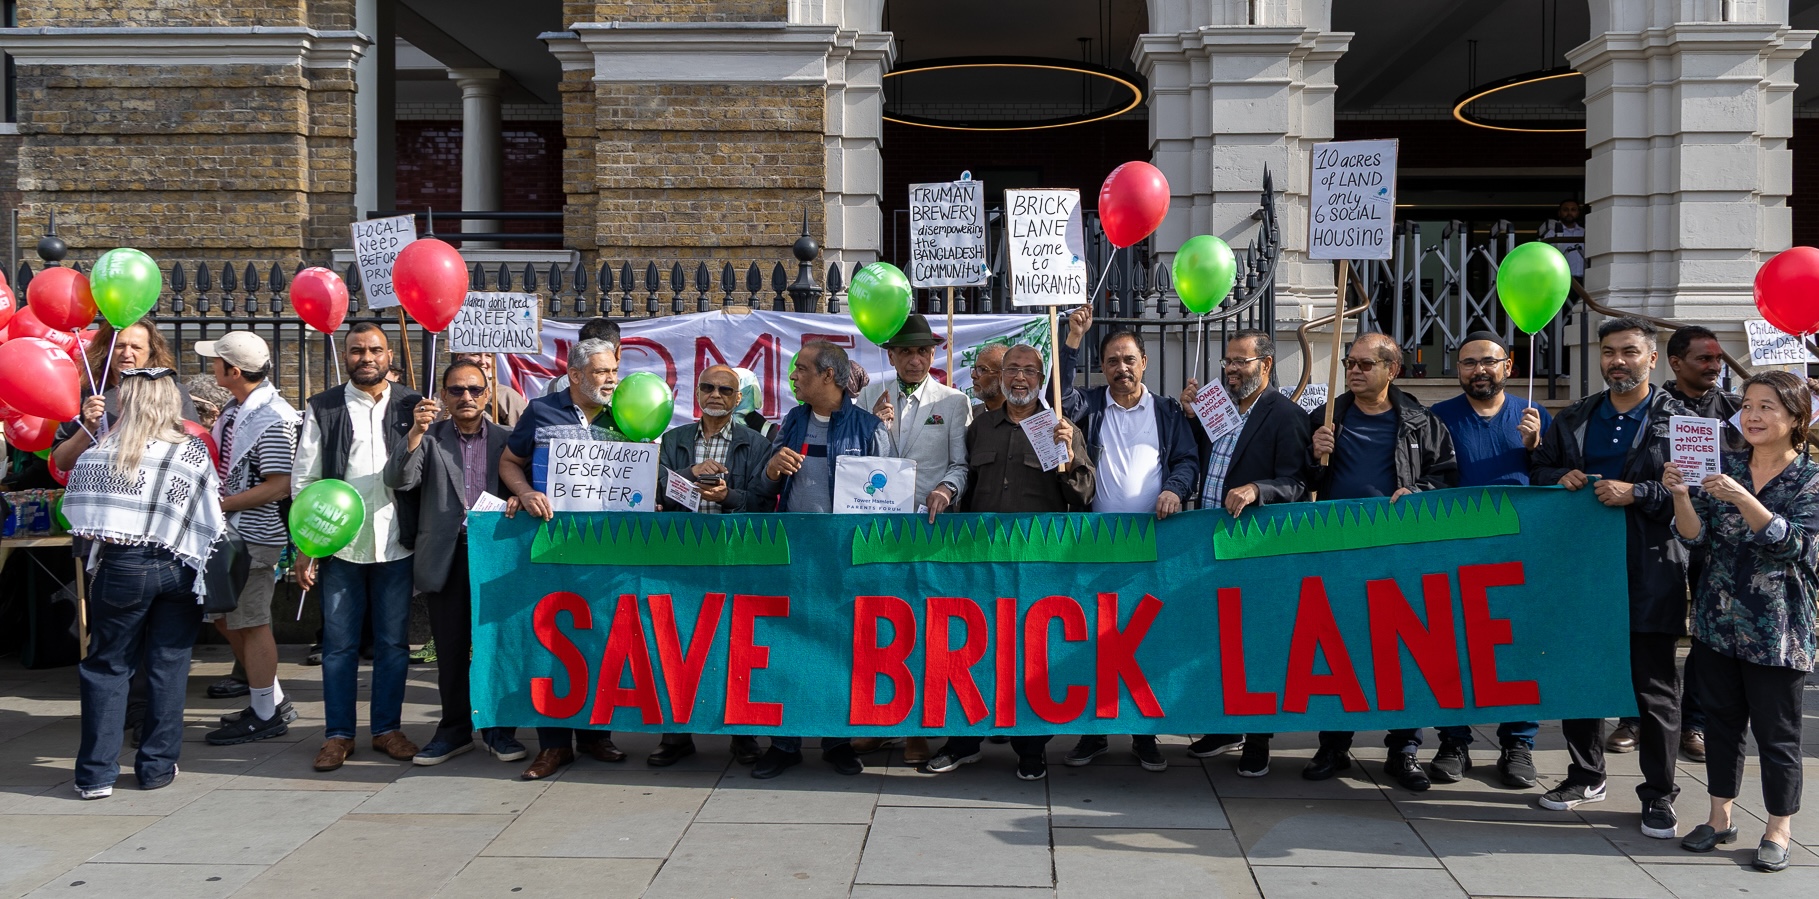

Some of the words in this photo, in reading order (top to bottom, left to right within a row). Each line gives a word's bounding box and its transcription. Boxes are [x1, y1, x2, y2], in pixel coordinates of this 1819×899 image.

[1316, 149, 1338, 169] 10
[1322, 172, 1336, 190] of
[1339, 172, 1382, 187] LAND
[914, 187, 975, 203] TRUMAN
[1328, 191, 1361, 211] only
[1315, 205, 1325, 223] 6
[357, 220, 408, 238] LOCAL
[1013, 220, 1068, 238] LANE
[915, 238, 937, 248] the
[1022, 240, 1063, 256] home
[360, 252, 399, 267] BEFOR
[1032, 258, 1048, 270] to
[366, 268, 392, 282] PRIV
[370, 282, 395, 297] GRE
[452, 310, 517, 326] CAREER
[1194, 385, 1220, 405] HOMES
[1204, 396, 1216, 407] NOT
[1201, 397, 1226, 418] OFFICES
[1676, 424, 1713, 435] HOMES
[555, 442, 586, 460] OUR
[1675, 444, 1714, 452] OFFICES
[555, 462, 634, 479] DESERVE
[297, 525, 331, 547] SAVE
[530, 591, 790, 726] SAVE
[848, 592, 1166, 728] BRICK
[1217, 560, 1540, 716] LANE
